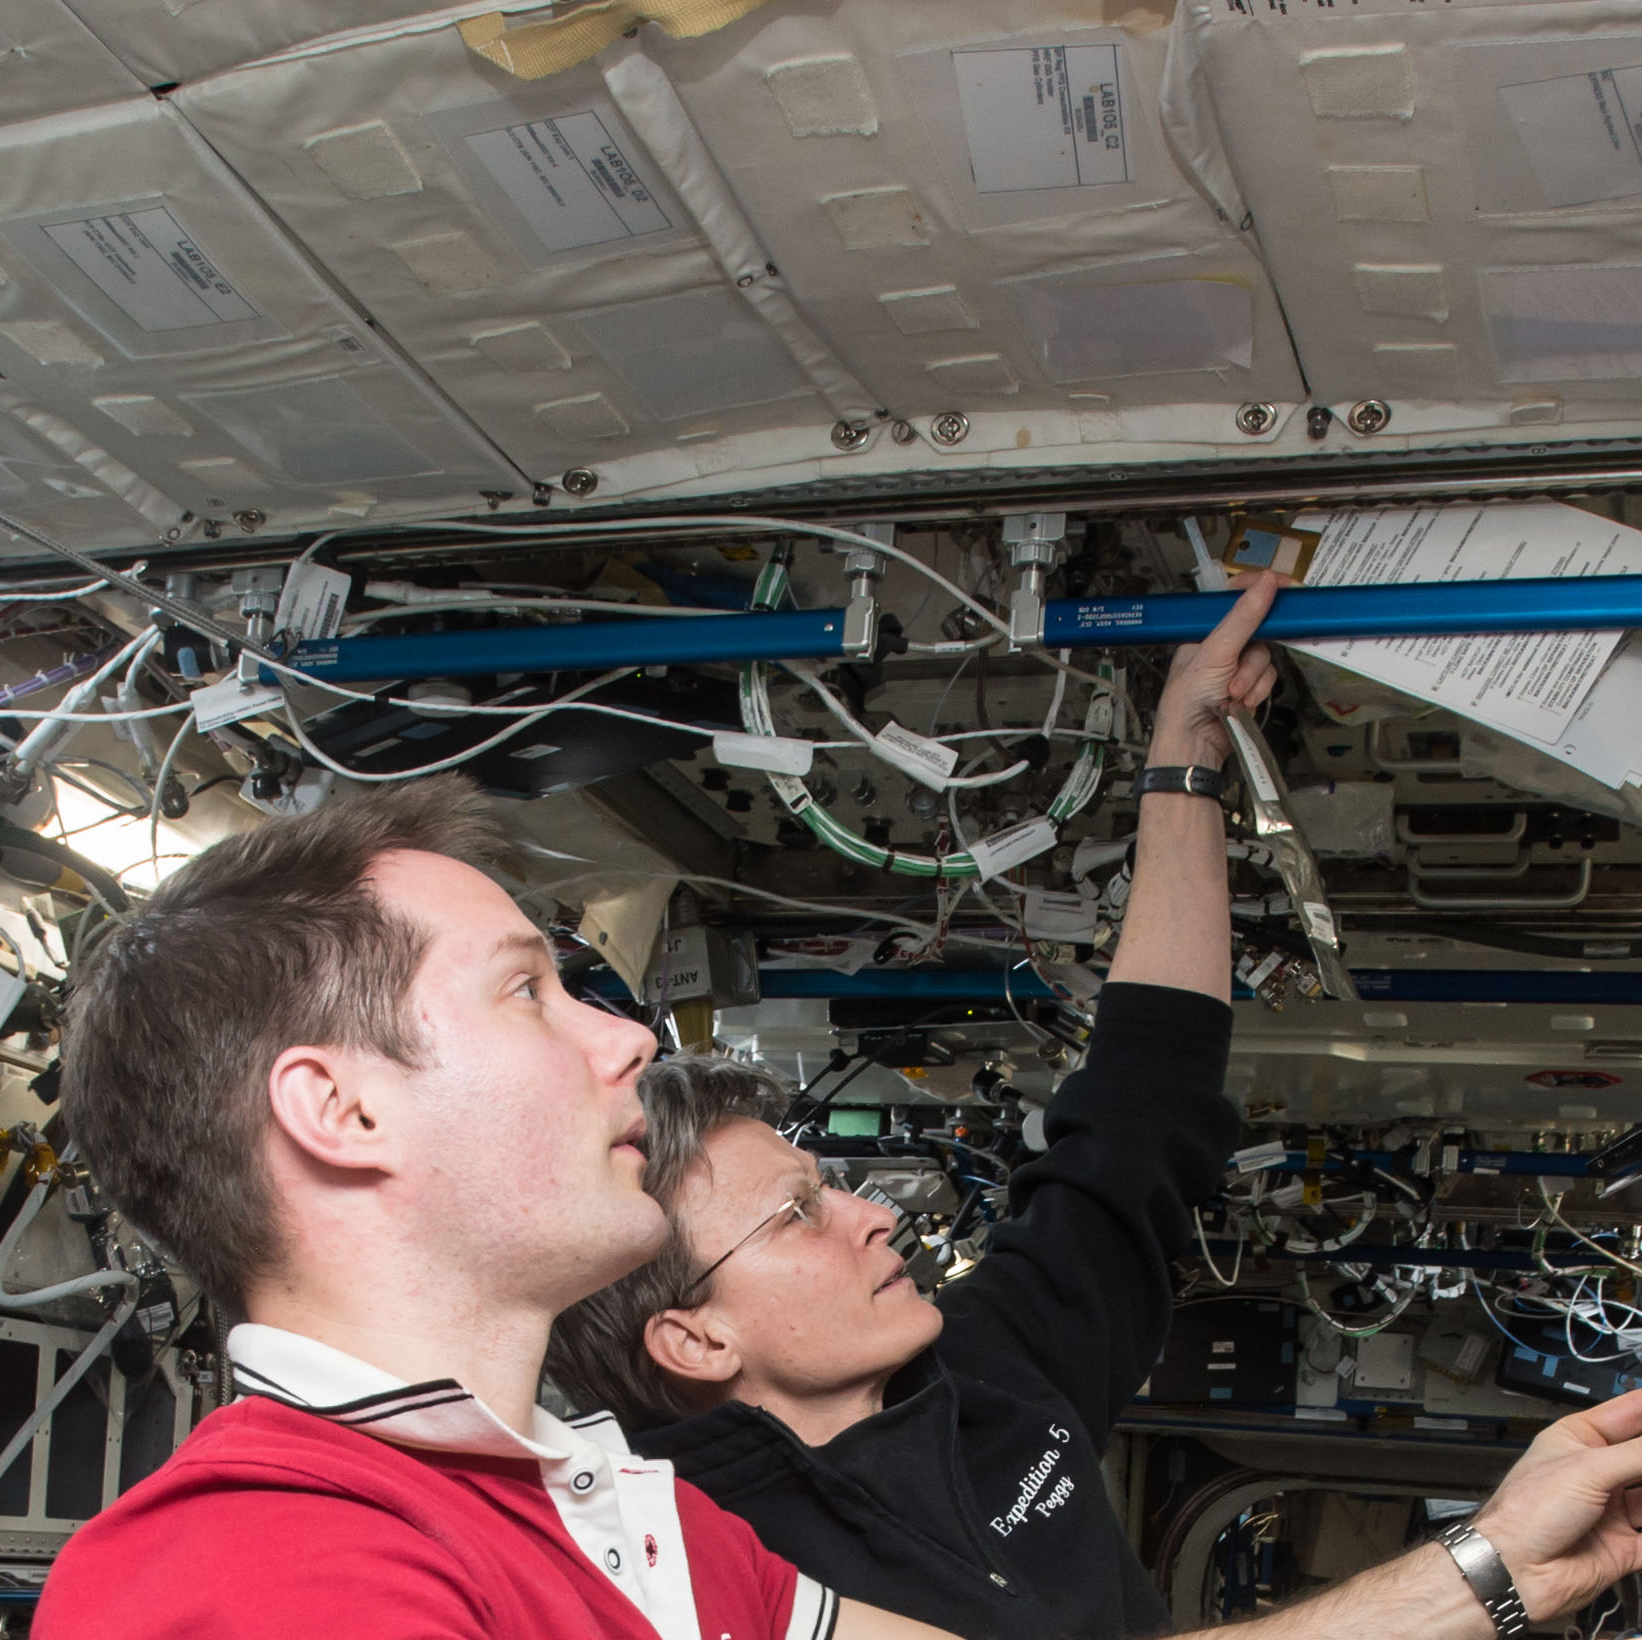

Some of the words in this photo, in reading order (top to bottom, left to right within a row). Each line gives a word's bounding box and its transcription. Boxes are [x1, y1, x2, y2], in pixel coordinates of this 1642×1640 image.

[988, 1448, 1061, 1540] Expedition
[1049, 1424, 1072, 1445] 5
[1034, 1474, 1074, 1518] Peggy
